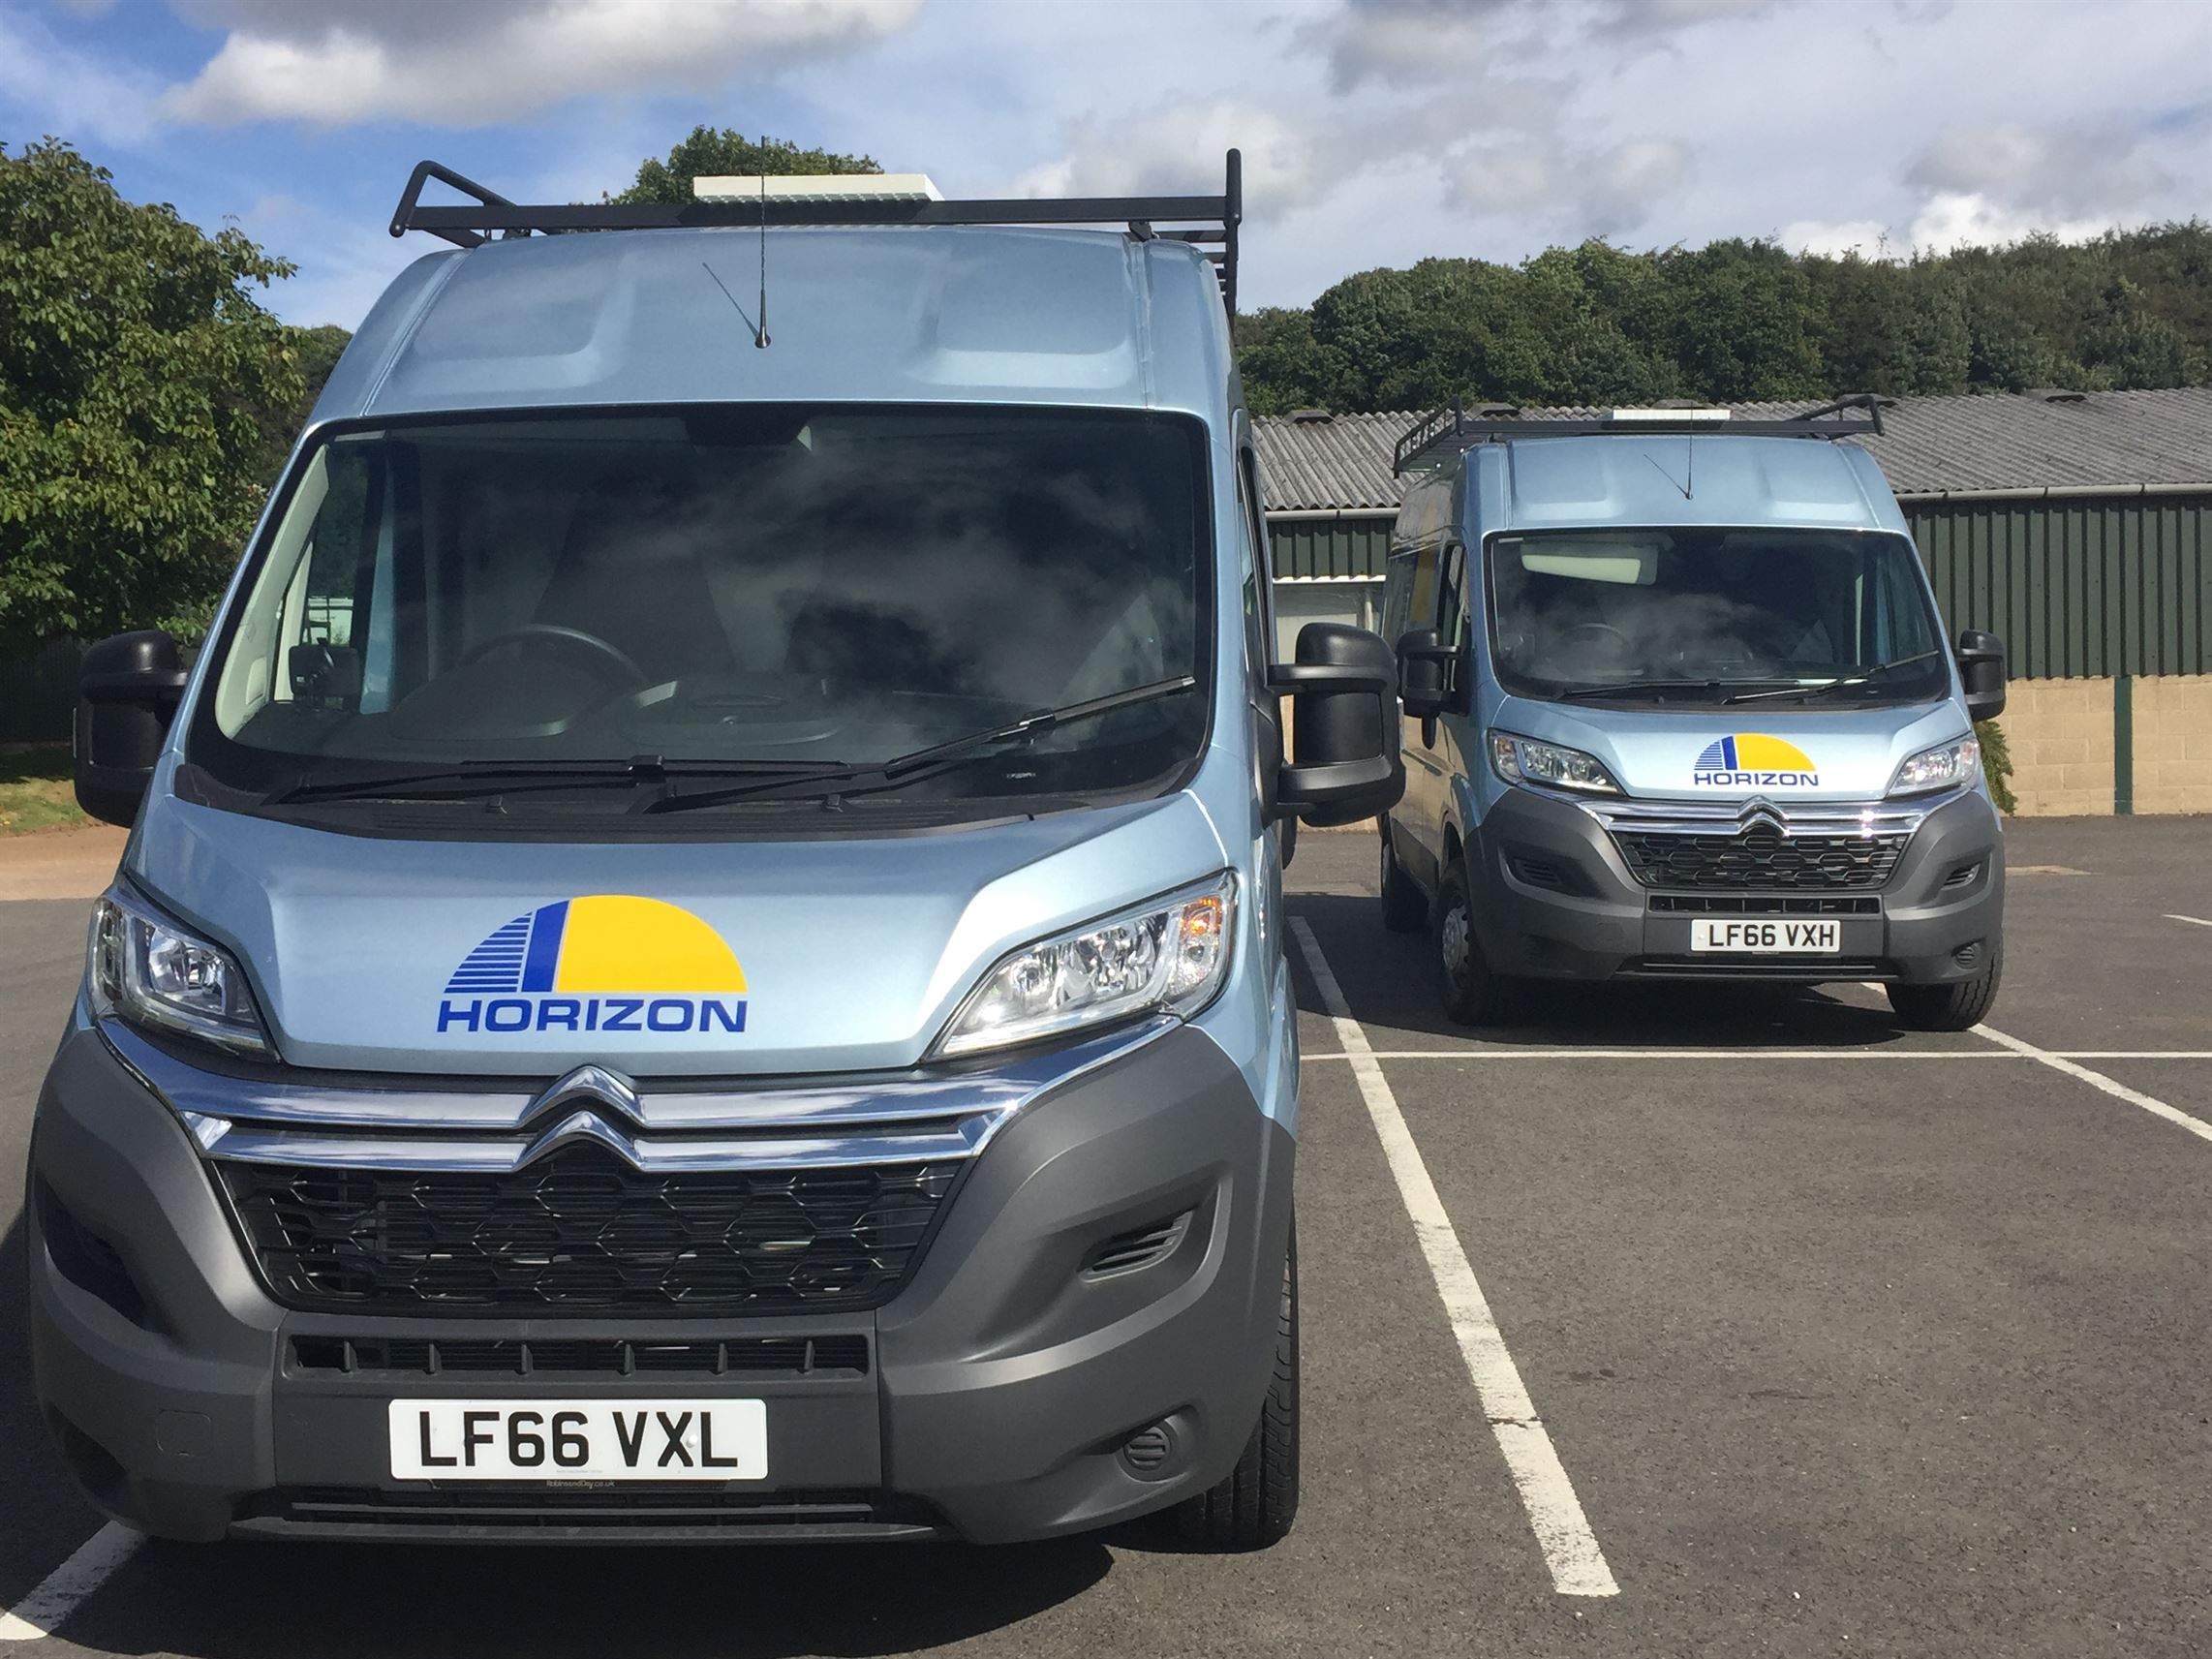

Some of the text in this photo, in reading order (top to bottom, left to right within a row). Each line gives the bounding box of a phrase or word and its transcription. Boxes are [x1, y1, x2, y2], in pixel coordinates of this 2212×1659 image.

[1694, 773, 1819, 785] HORIZON
[1708, 924, 1834, 946] LF66 VXH
[437, 998, 749, 1032] HORIZON
[419, 1411, 738, 1467] LF66 VXL
